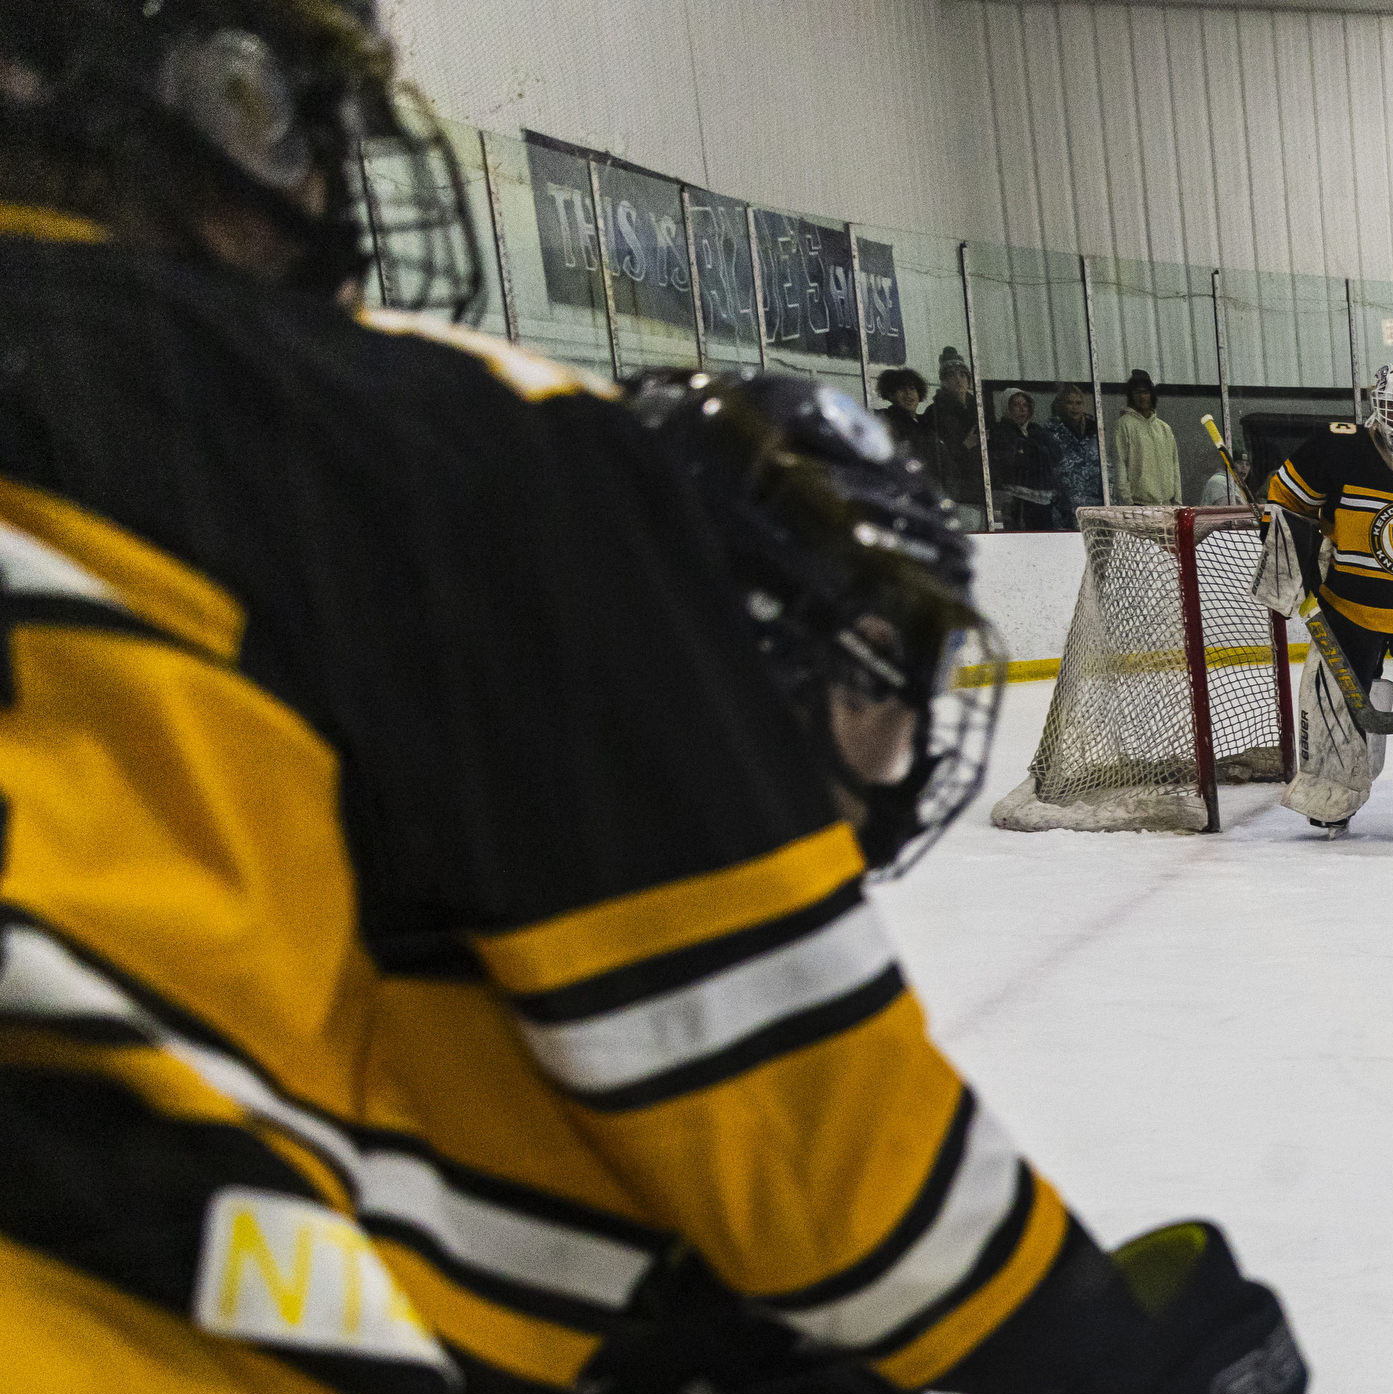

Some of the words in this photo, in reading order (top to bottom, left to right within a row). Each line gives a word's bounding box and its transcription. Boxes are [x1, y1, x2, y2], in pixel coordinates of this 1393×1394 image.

[547, 182, 646, 281] THIS
[649, 211, 690, 293] IS
[1301, 709, 1309, 761] BAUER
